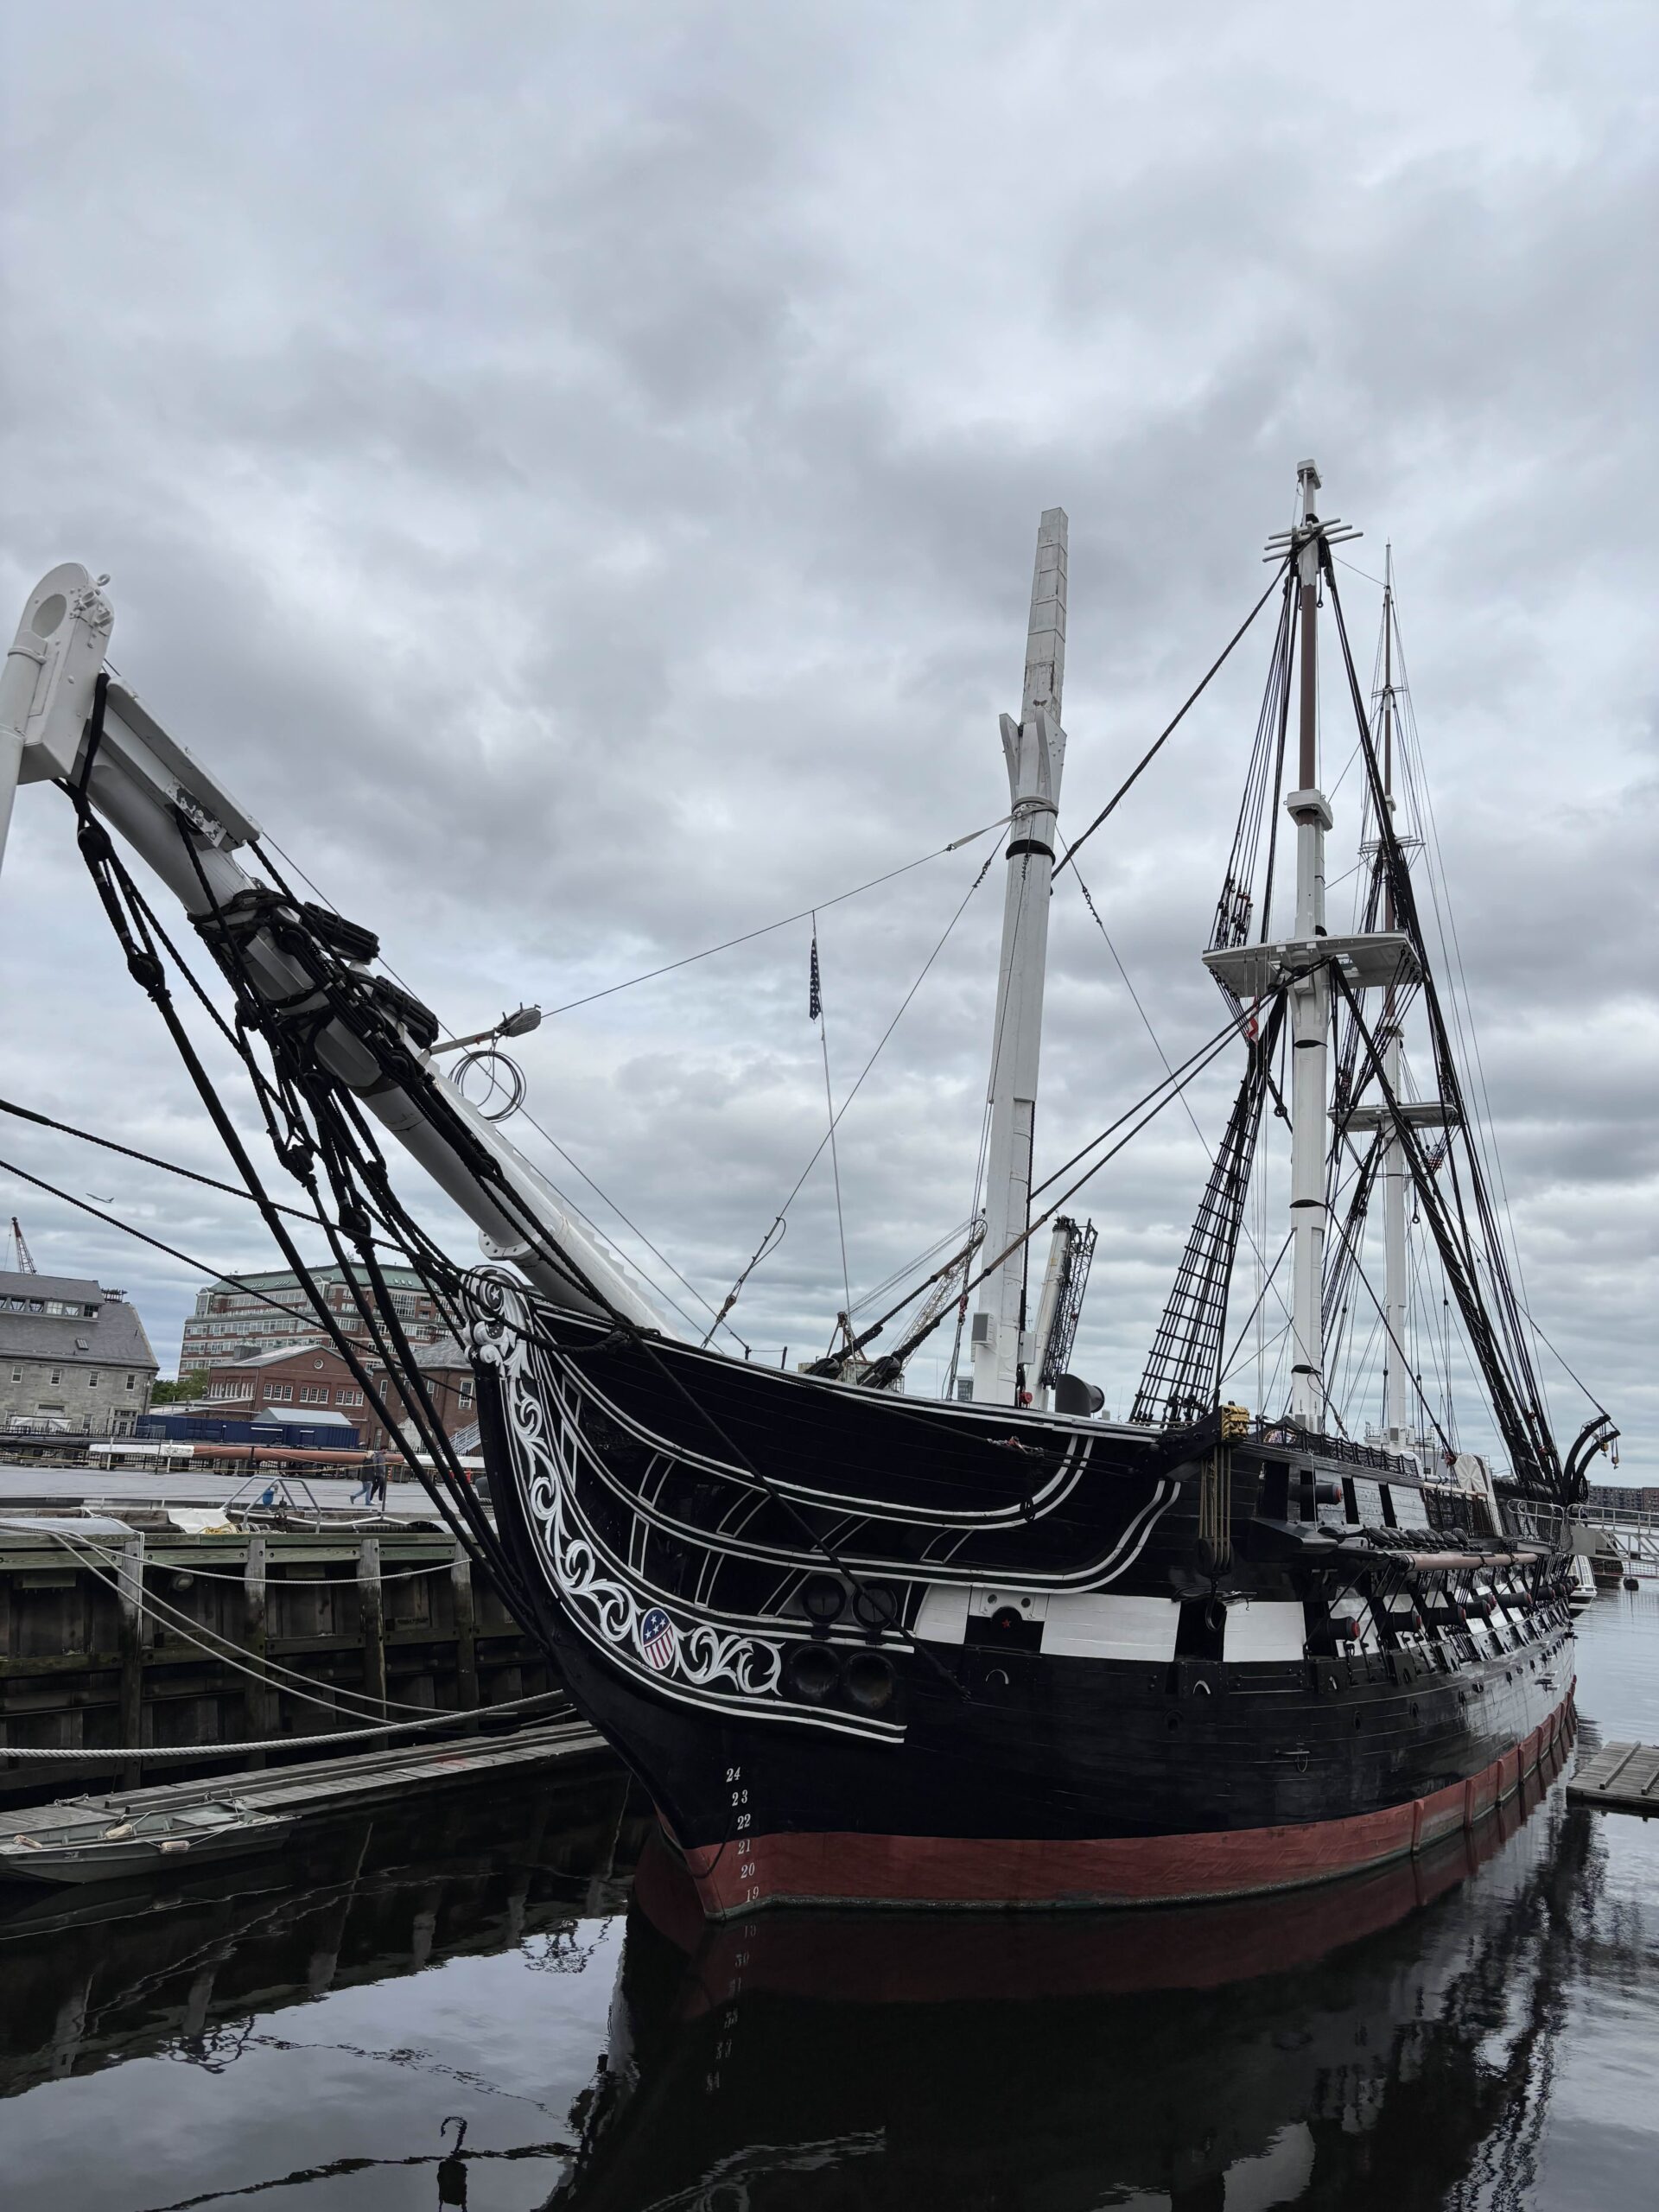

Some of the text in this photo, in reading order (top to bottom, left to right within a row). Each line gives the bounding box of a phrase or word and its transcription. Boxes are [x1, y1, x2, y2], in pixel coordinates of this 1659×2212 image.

[726, 1766, 741, 1783] 24
[731, 1789, 748, 1807] 23
[737, 1813, 752, 1831] 22
[737, 1839, 751, 1855] 21
[741, 1862, 755, 1879] 20
[746, 1886, 760, 1903] 19
